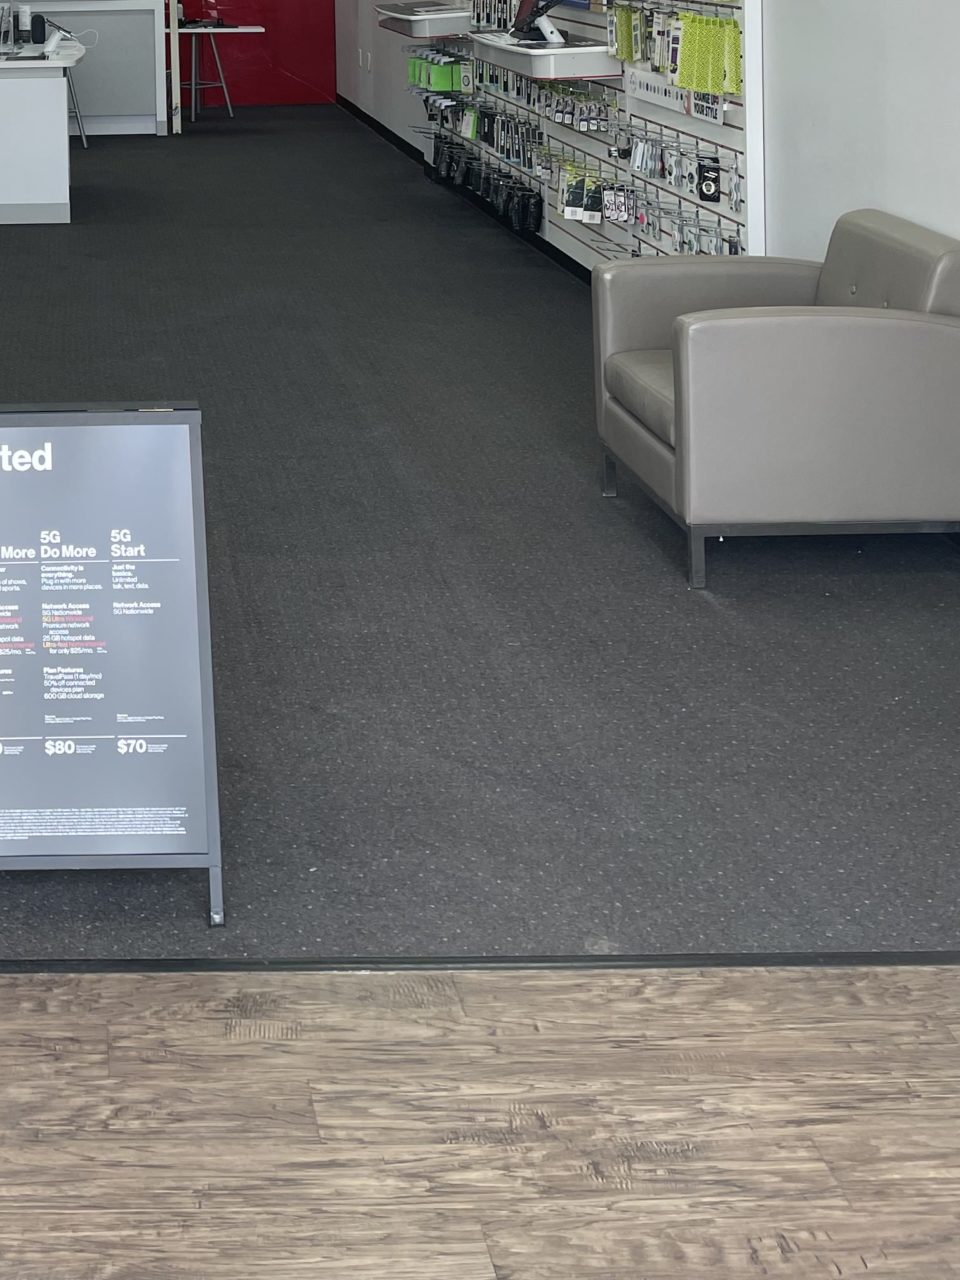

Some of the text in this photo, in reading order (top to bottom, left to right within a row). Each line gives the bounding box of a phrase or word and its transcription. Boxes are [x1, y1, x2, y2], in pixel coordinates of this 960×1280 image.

[705, 105, 718, 120] STYLE
[40, 530, 61, 544] 5G
[110, 528, 131, 542] 5G
[0, 545, 36, 559] More
[40, 544, 97, 558] Do More
[110, 543, 146, 557] Start
[44, 740, 75, 756] $80
[116, 738, 147, 755] $70
